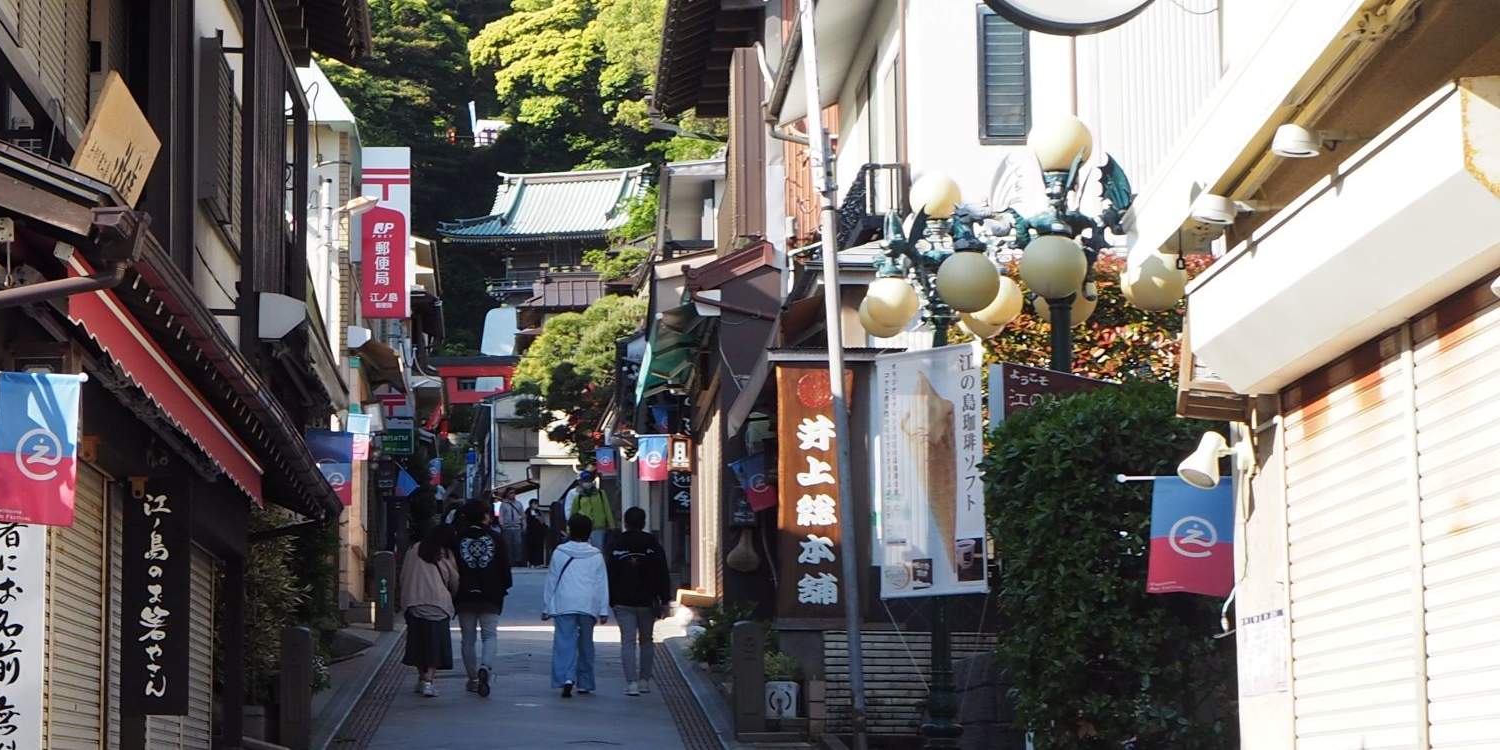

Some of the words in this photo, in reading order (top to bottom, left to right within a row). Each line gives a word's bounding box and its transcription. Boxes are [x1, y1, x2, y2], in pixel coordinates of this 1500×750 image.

[374, 241, 390, 286] 郵便局
[1009, 368, 1050, 386] ようこそ
[959, 352, 977, 512] 江の島珈琲ソフト
